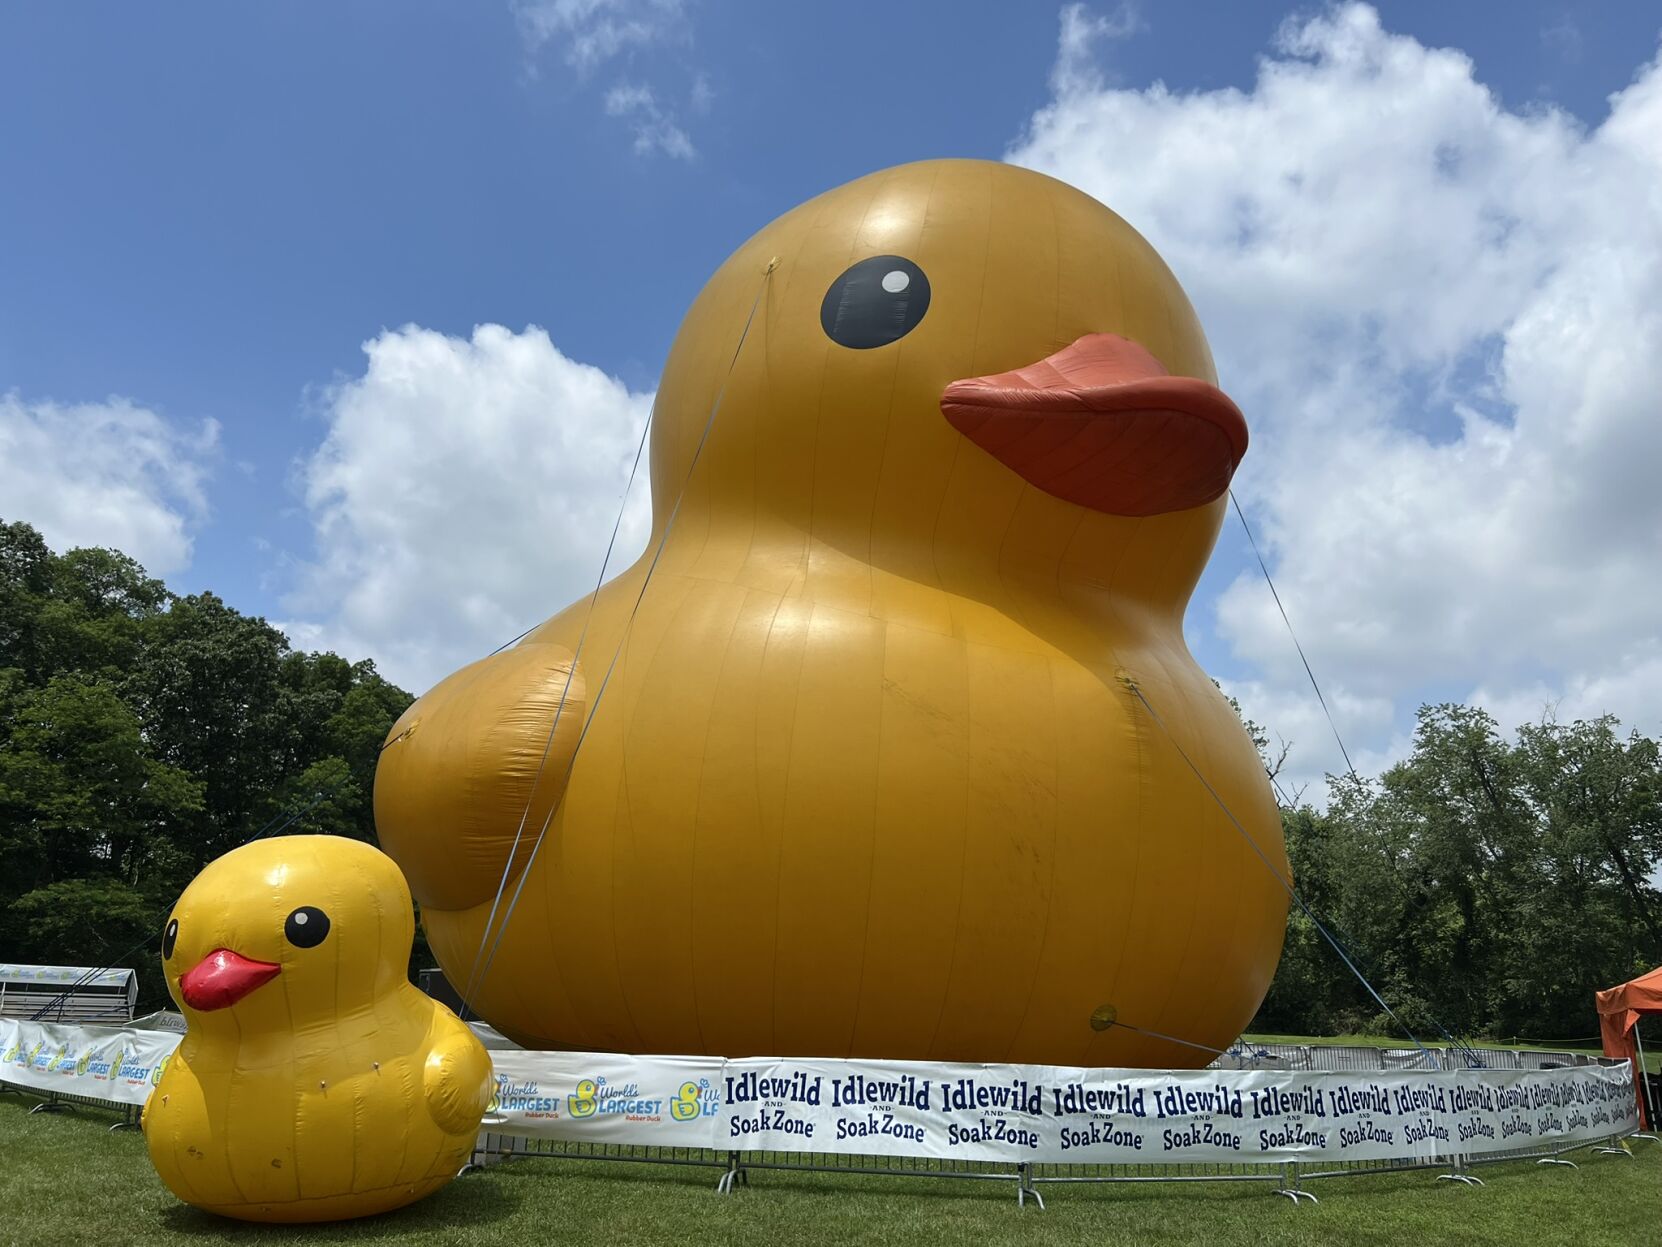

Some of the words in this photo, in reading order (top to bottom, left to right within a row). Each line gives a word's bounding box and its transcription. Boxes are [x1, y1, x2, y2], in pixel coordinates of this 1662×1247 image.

[118, 1064, 150, 1079] LARGEST
[501, 1097, 560, 1112] LARGEST
[502, 1081, 538, 1096] World's
[600, 1084, 639, 1099] World's
[725, 1071, 821, 1106] Idlewild
[832, 1075, 930, 1110] Idlewild
[941, 1079, 1043, 1115] Idlewild
[1052, 1083, 1146, 1118] Idlewild
[1153, 1084, 1243, 1119] Idlewild
[1251, 1084, 1326, 1119] Idlewild
[1329, 1084, 1391, 1117] Idlewild
[1393, 1083, 1447, 1115] Idlewild
[1449, 1083, 1494, 1114] Idlewild
[1494, 1083, 1530, 1112] Idlewild
[598, 1100, 662, 1115] LARGEST
